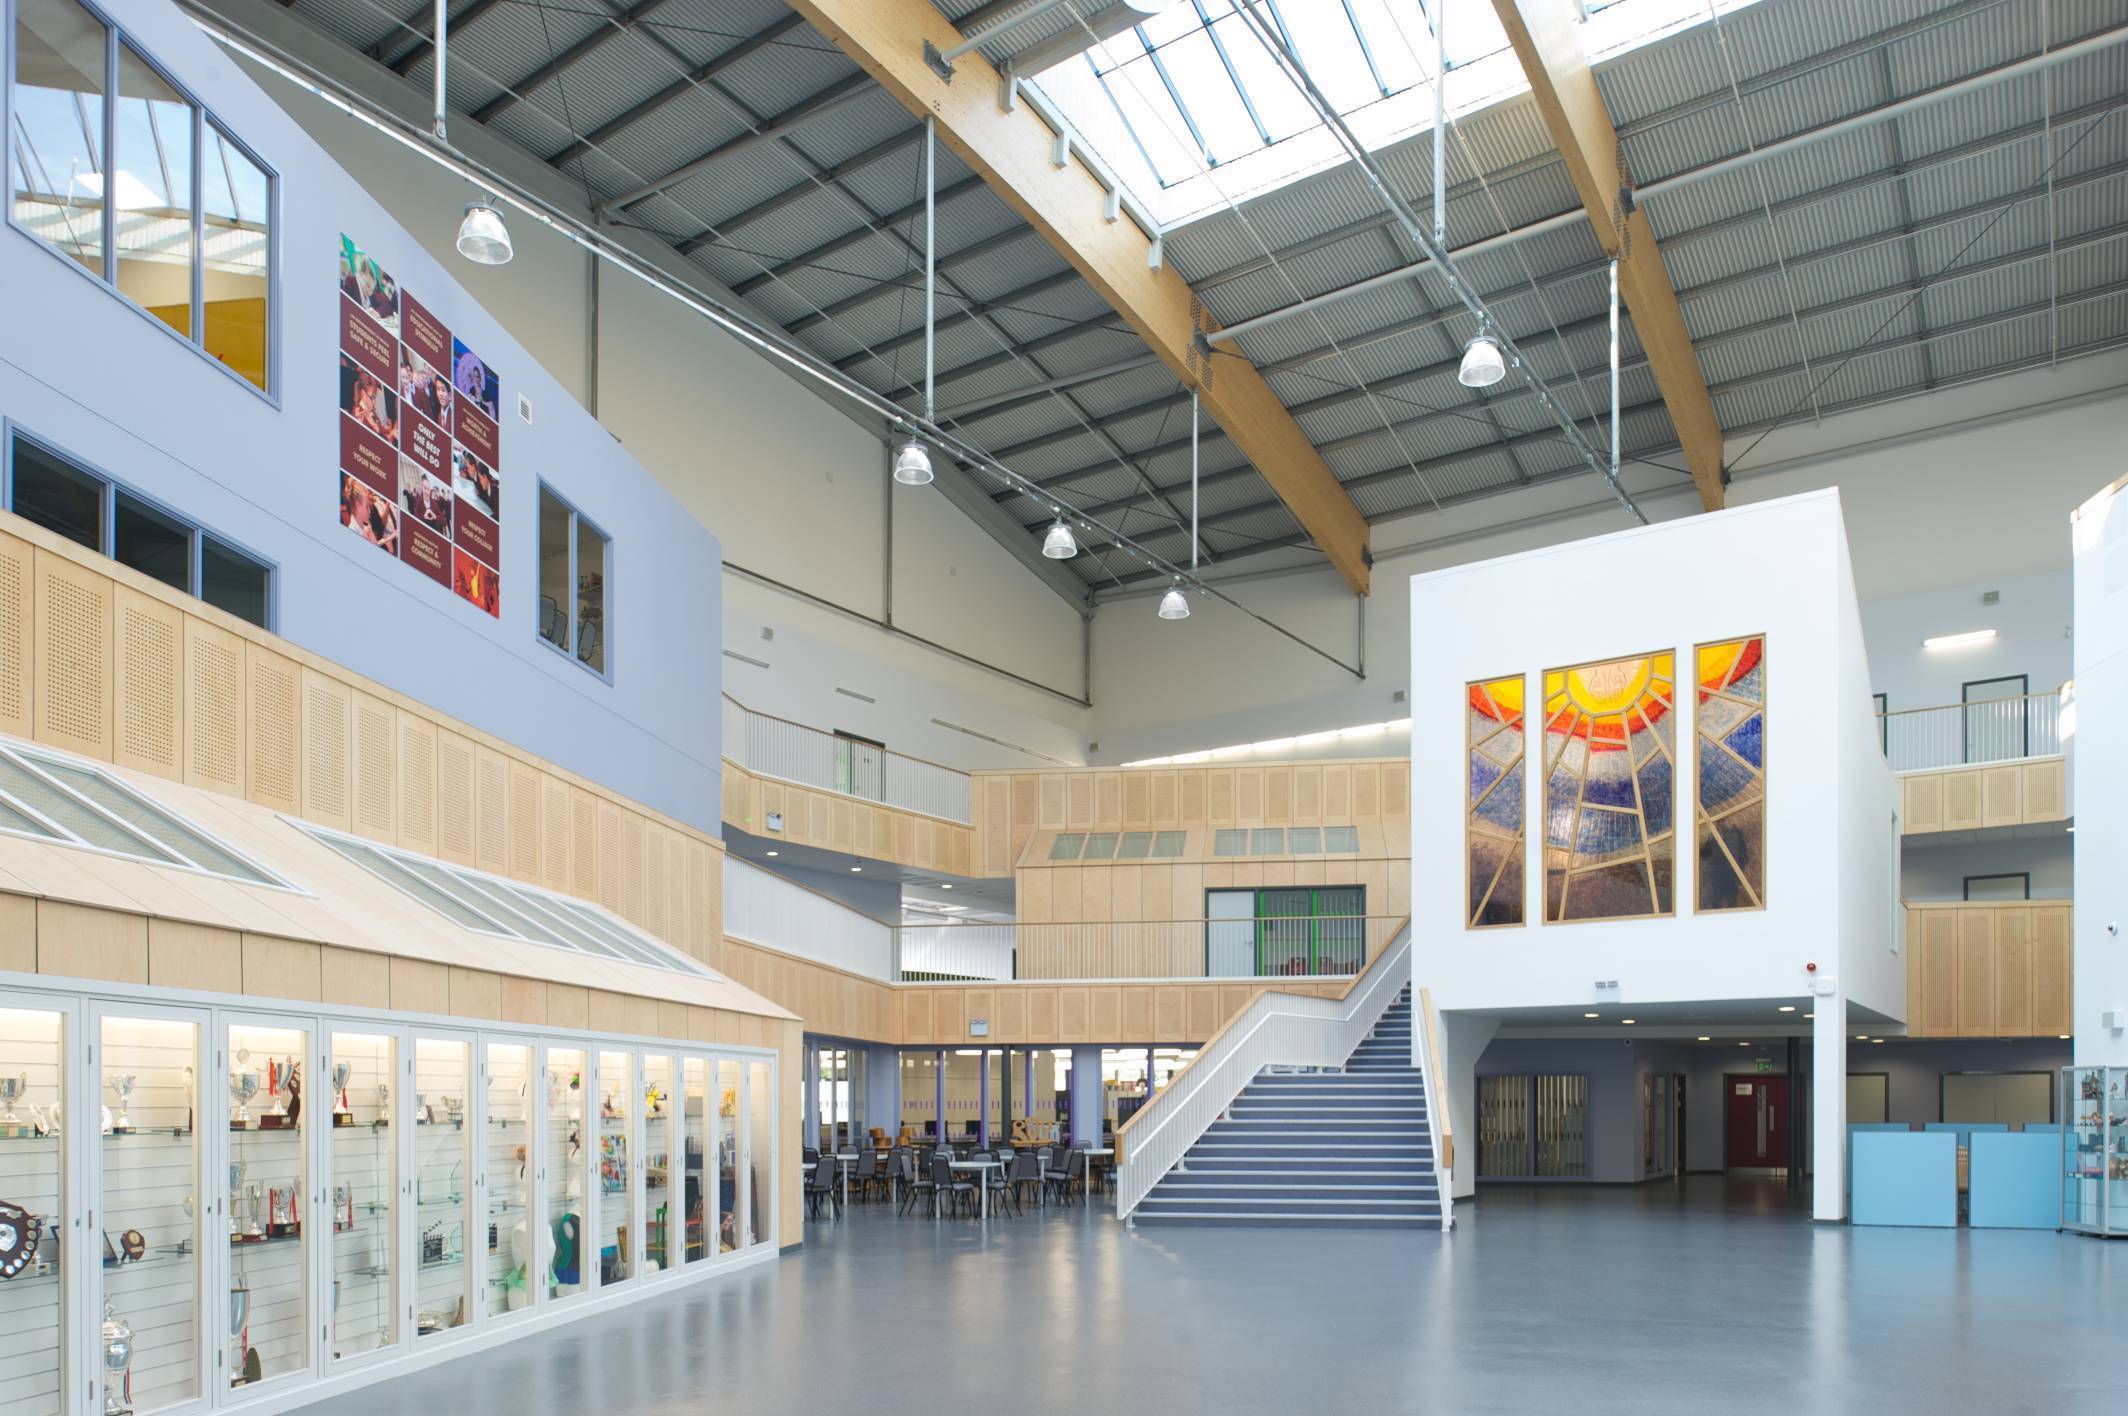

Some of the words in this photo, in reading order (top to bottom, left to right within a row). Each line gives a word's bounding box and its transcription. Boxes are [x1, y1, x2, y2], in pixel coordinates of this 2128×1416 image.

[350, 319, 378, 348] STUDENTS
[377, 343, 390, 358] FEEL
[409, 313, 443, 349] EDUCATIONAL
[350, 330, 364, 347] SAFE
[369, 346, 390, 368] SECURE
[413, 430, 426, 446] THE
[425, 440, 441, 457] BEST
[418, 423, 436, 441] ONLY
[352, 450, 369, 468] YOUR
[369, 463, 387, 481] WORK
[358, 443, 381, 465] RESPECT
[413, 443, 429, 461] WILL
[429, 454, 441, 468] DO
[461, 524, 474, 540] YOUR
[468, 520, 486, 538] RESPECT
[410, 544, 442, 569] COMMUNITY
[413, 537, 434, 556] RESPECT
